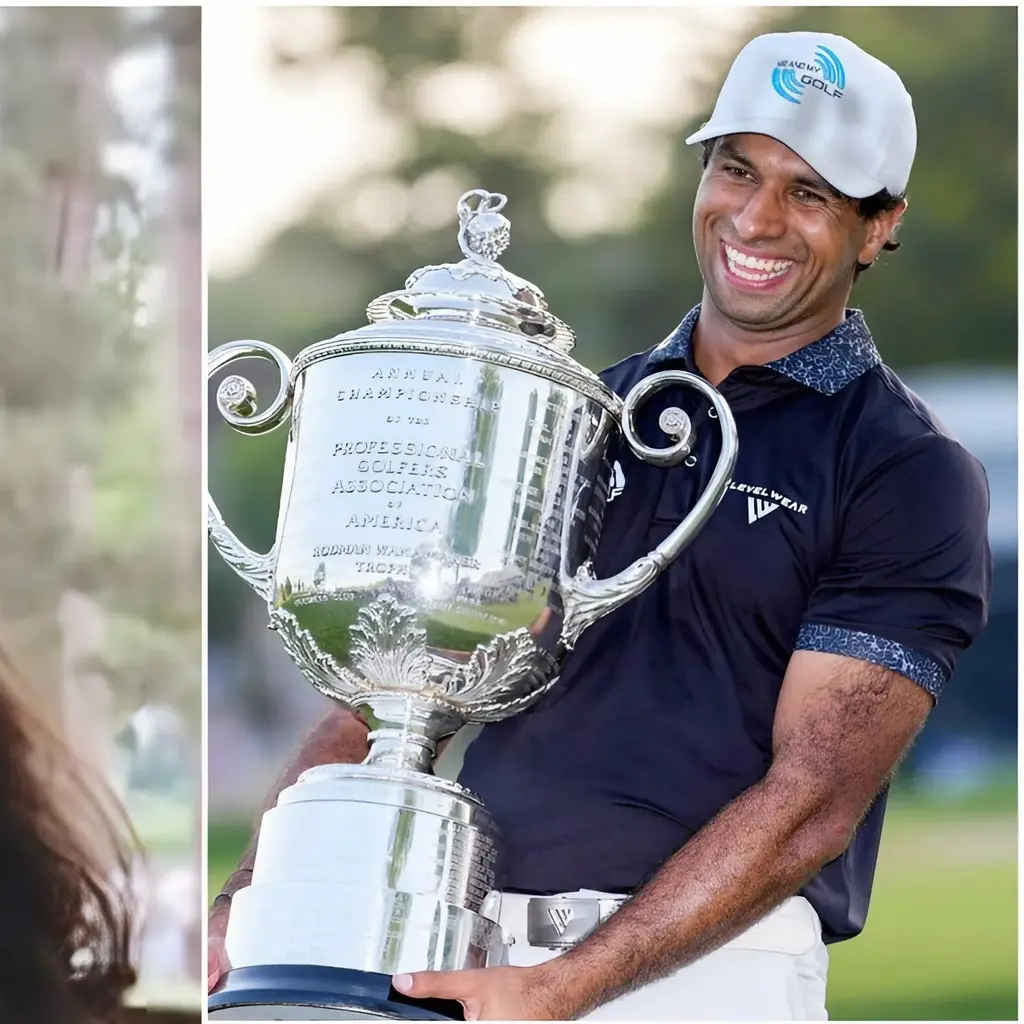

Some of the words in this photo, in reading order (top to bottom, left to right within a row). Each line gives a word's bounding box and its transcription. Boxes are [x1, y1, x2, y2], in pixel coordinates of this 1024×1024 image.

[800, 74, 844, 99] GOLF
[372, 367, 464, 386] ANNUAL
[357, 460, 448, 479] GOLFERS
[345, 513, 442, 533] AMERICA
[355, 561, 416, 577] TROPH
